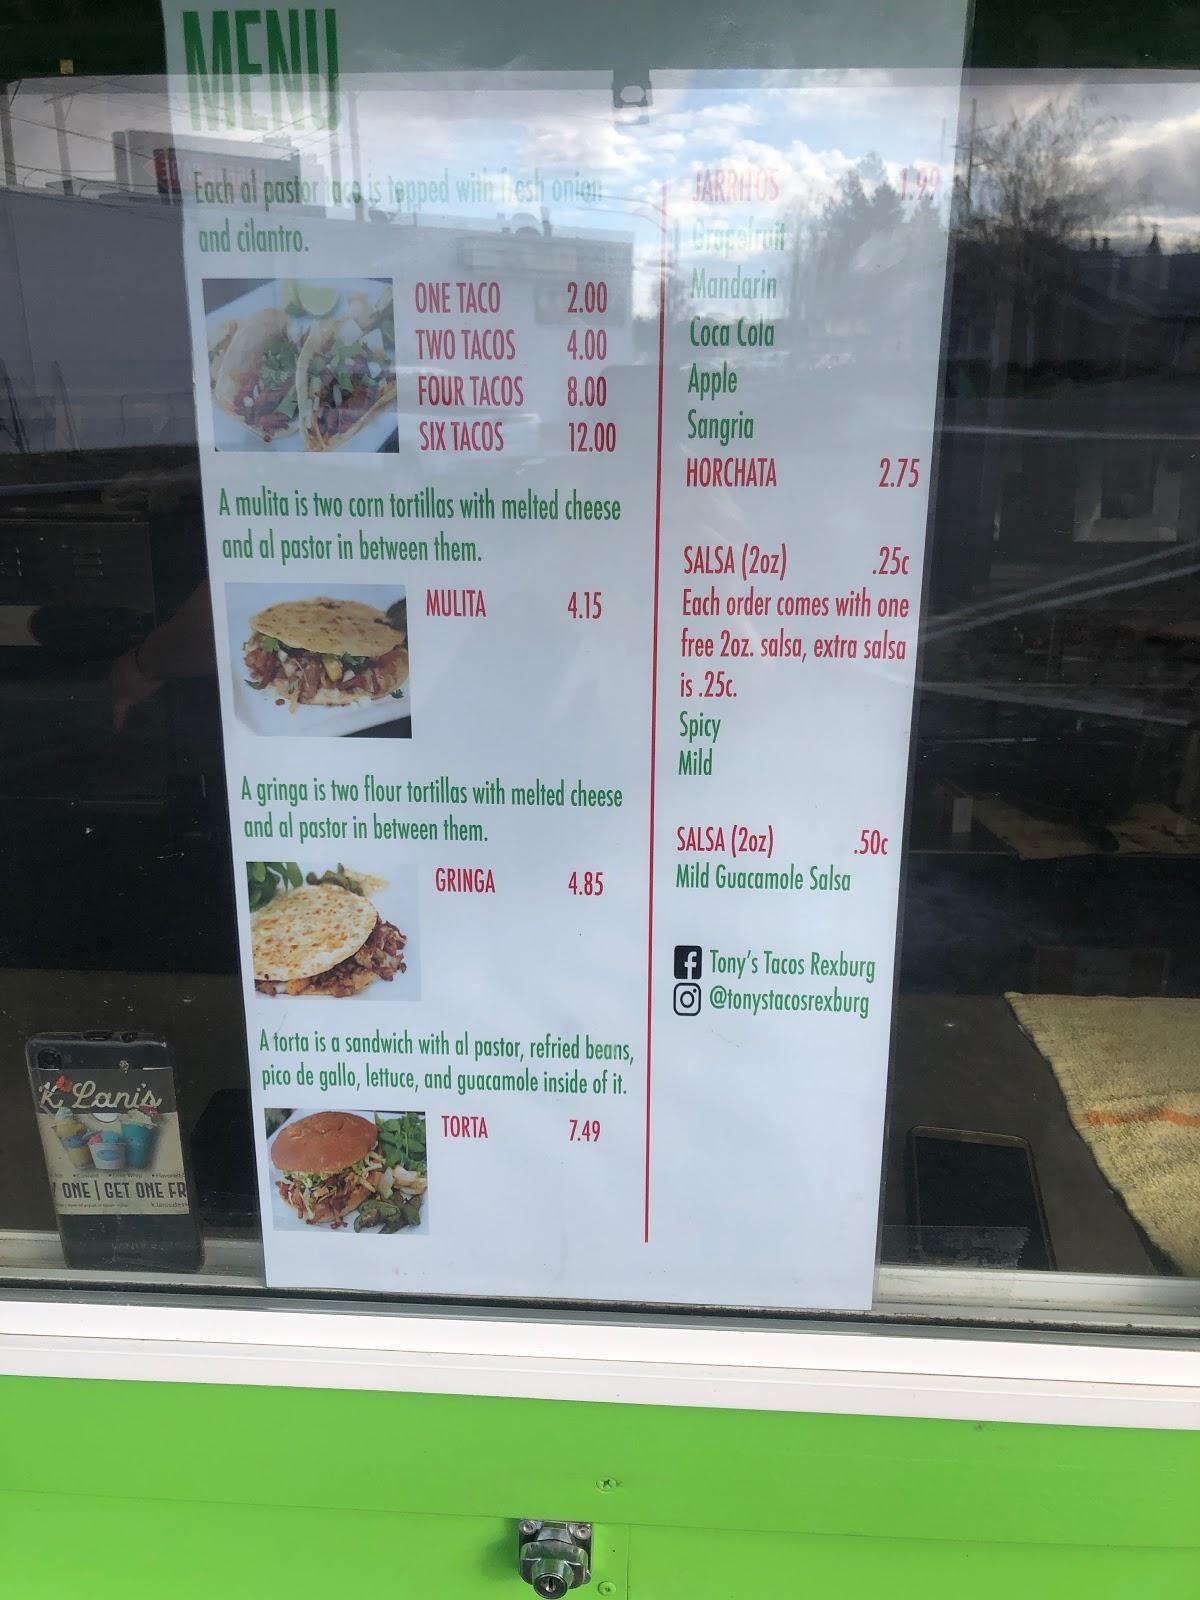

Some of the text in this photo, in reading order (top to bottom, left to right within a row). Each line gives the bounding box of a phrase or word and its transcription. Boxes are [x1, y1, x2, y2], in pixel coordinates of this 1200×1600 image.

[182, 8, 341, 132] MENU
[194, 168, 234, 204] Each
[241, 168, 256, 203] al
[264, 176, 318, 212] pastor
[368, 174, 381, 203] is
[388, 168, 448, 211] topped
[693, 167, 940, 202] JARRITOS 1.99
[199, 217, 309, 253] and cilantro.
[415, 281, 607, 314] ONE TACO 2.00
[690, 265, 777, 300] Mandarin
[415, 329, 607, 361] TWO TACOS 4.00
[690, 316, 775, 347] Coca Cola
[418, 375, 607, 407] FOUR TACOS 8.00
[688, 360, 738, 401] Apple
[420, 421, 617, 453] SIX TACOS 12.00
[687, 409, 754, 446] Sangria
[686, 457, 920, 488] HORCHATA 2.75
[219, 485, 621, 521] A mulita is two corn tortillas with melted cheese
[223, 528, 482, 566] and al pastor in between them.
[683, 543, 910, 581] SALSA (2oz) .25c
[426, 589, 602, 620] MULITA 4.15
[682, 586, 909, 618] Each order comes with one
[680, 627, 907, 663] free 2oz. salsa, extra salsa
[680, 670, 737, 698] is .25c.
[679, 710, 721, 743] Spicy
[678, 747, 713, 776] Mild
[241, 775, 623, 807] A gringa is two flour tortillas with melted cheese
[244, 811, 488, 844] and al pastor in between them.
[677, 824, 889, 858] SALSA (2oz) .50c
[435, 867, 604, 897] GRINGA 4.85
[676, 861, 851, 891] Mild Guacamole Salsa
[709, 949, 876, 983] Tony's Tacos Rexburg
[709, 985, 869, 1019] @tonystacosrexburg
[259, 1028, 634, 1066] A torta is a sandwich with al pastor, refried beans,
[262, 1061, 627, 1096] pico de gallo, lettuce, and guacamole inside of it.
[441, 1115, 601, 1142] TORTA 7.49
[62, 1182, 92, 1199] ONE
[104, 1181, 131, 1199] GET
[136, 1182, 165, 1199] ONE
